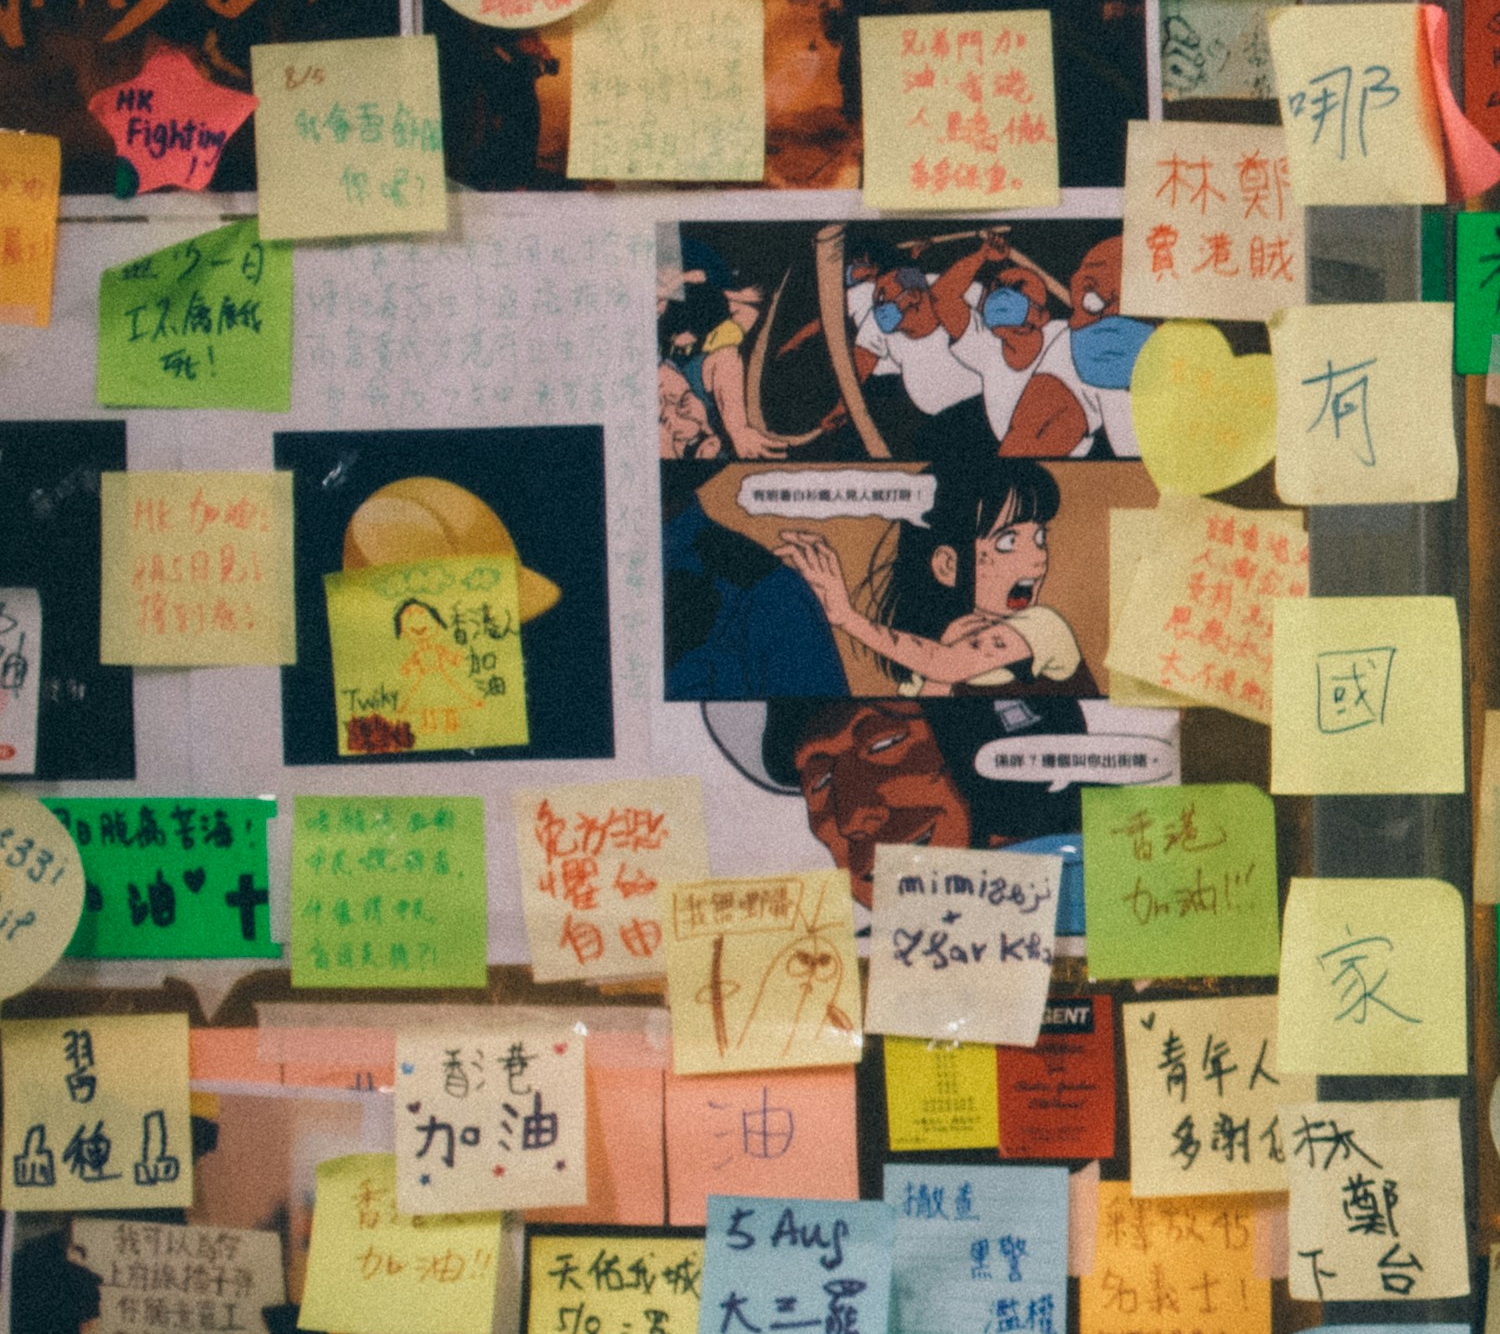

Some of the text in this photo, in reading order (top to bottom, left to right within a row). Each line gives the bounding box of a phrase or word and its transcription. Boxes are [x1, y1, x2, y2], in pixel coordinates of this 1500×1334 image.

[116, 90, 154, 114] HK
[558, 918, 666, 967] 自由
[413, 1096, 563, 1167] 加油
[726, 1209, 850, 1271] 5 Aug
[1298, 1242, 1425, 1300] 下台
